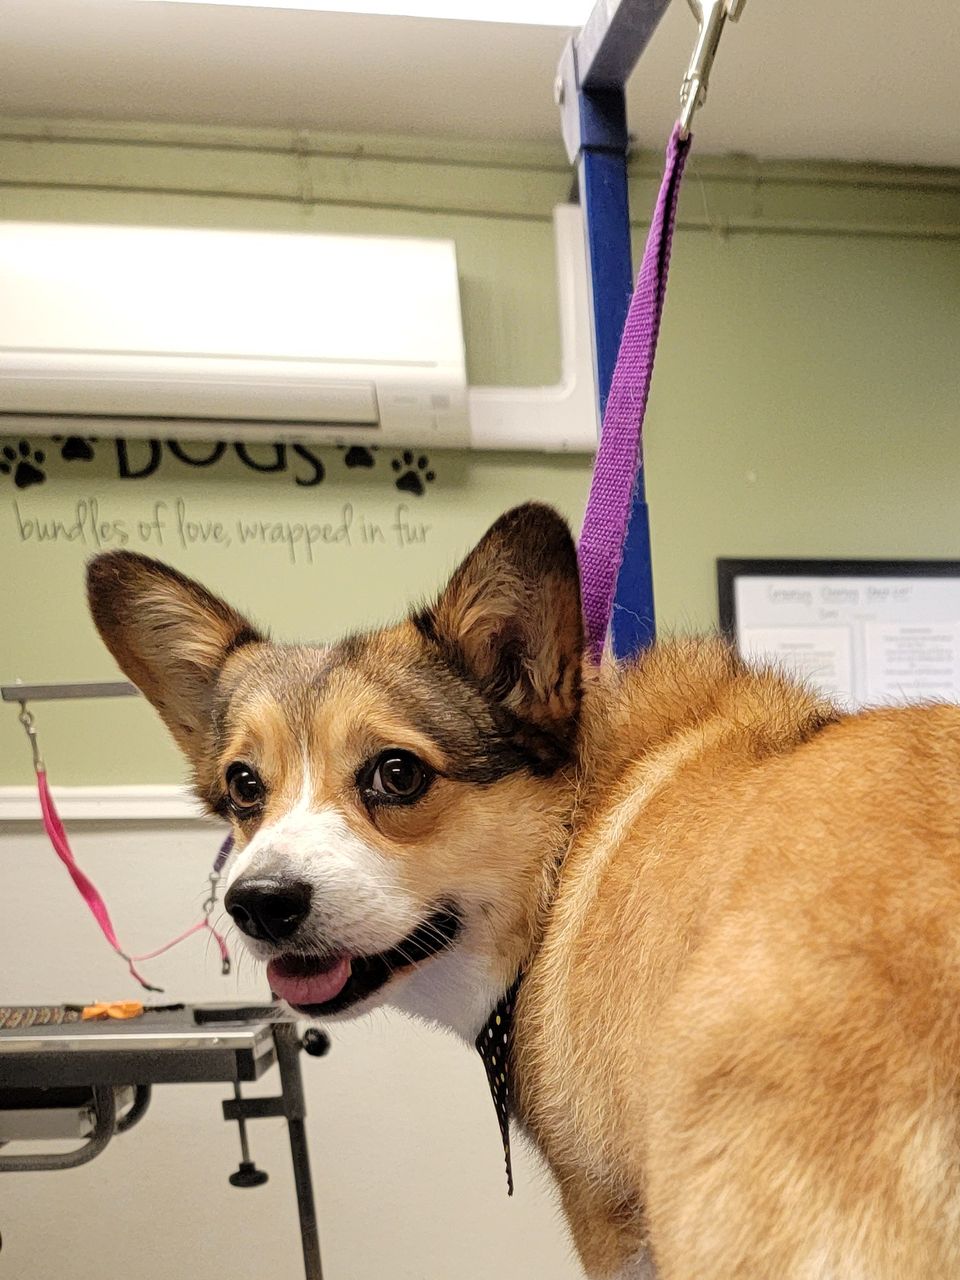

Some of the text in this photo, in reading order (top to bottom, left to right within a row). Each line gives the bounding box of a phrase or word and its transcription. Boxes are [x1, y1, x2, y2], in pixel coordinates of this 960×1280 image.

[14, 497, 431, 565] bundles of love, wrapped in fur
